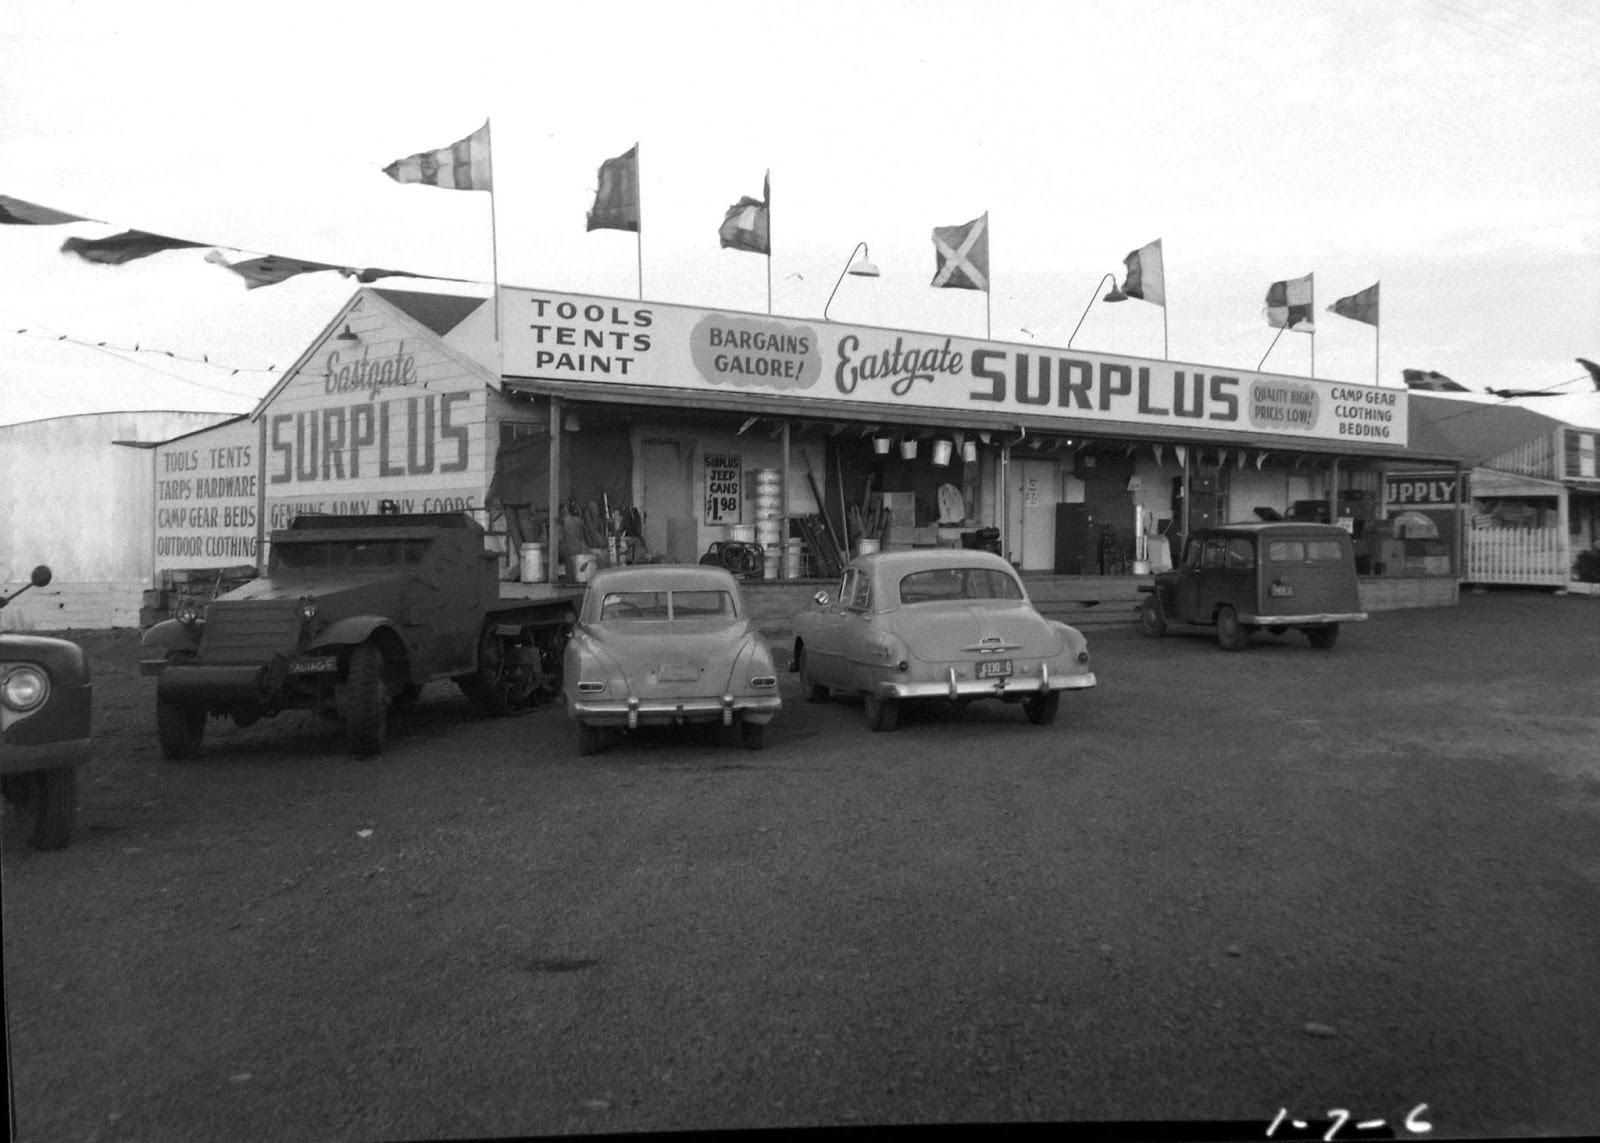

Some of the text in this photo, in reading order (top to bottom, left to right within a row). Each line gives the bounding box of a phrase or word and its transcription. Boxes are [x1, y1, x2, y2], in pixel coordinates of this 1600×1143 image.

[531, 298, 653, 328] TOOLS
[530, 324, 651, 352] TENTS
[709, 327, 810, 356] BARGAINS
[325, 340, 415, 401] Eastgate
[536, 350, 635, 375] PAINT
[714, 354, 804, 381] GALORE!
[835, 335, 1239, 422] Eastgate SURPLUS
[1254, 386, 1315, 406] QUALITY HIGH!
[1331, 387, 1397, 406] CAMP GEAR
[1254, 405, 1313, 425] PRICES LOW!
[1335, 405, 1393, 422] CLOTHING
[271, 391, 470, 484] SURPLUS
[1339, 422, 1390, 438] BEDDING
[164, 446, 252, 473] TOOLS TENTS
[158, 475, 257, 500] TARPS HARDWARE
[709, 482, 738, 494] CANS
[710, 470, 736, 481] JEEP
[158, 505, 256, 528] CAMP GEAR BEDS
[157, 536, 258, 557] OUTDOOR CLOTHING
